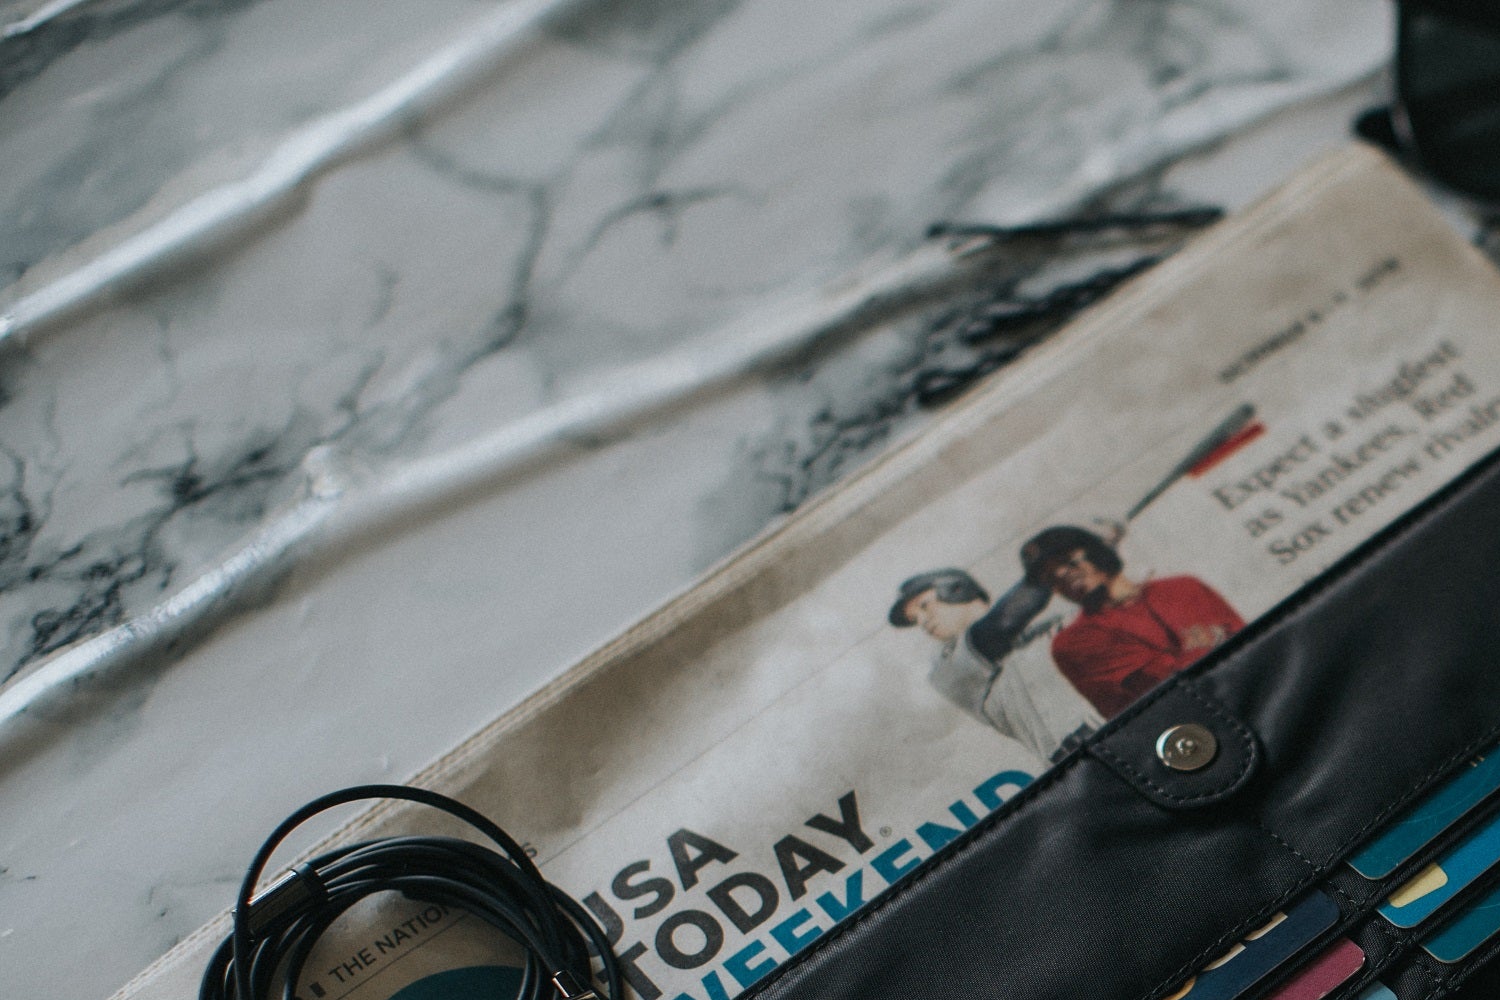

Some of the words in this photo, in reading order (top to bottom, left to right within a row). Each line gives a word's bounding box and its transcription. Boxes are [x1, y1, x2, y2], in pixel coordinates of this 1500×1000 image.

[1210, 432, 1319, 514] Expect
[1321, 418, 1345, 441] a
[1244, 506, 1283, 538] as
[1280, 409, 1419, 516] Yankees,
[1412, 372, 1474, 421] Red
[1267, 518, 1331, 567] Sox
[1331, 457, 1421, 525] renew
[582, 828, 739, 957] USA
[328, 949, 377, 984] THE
